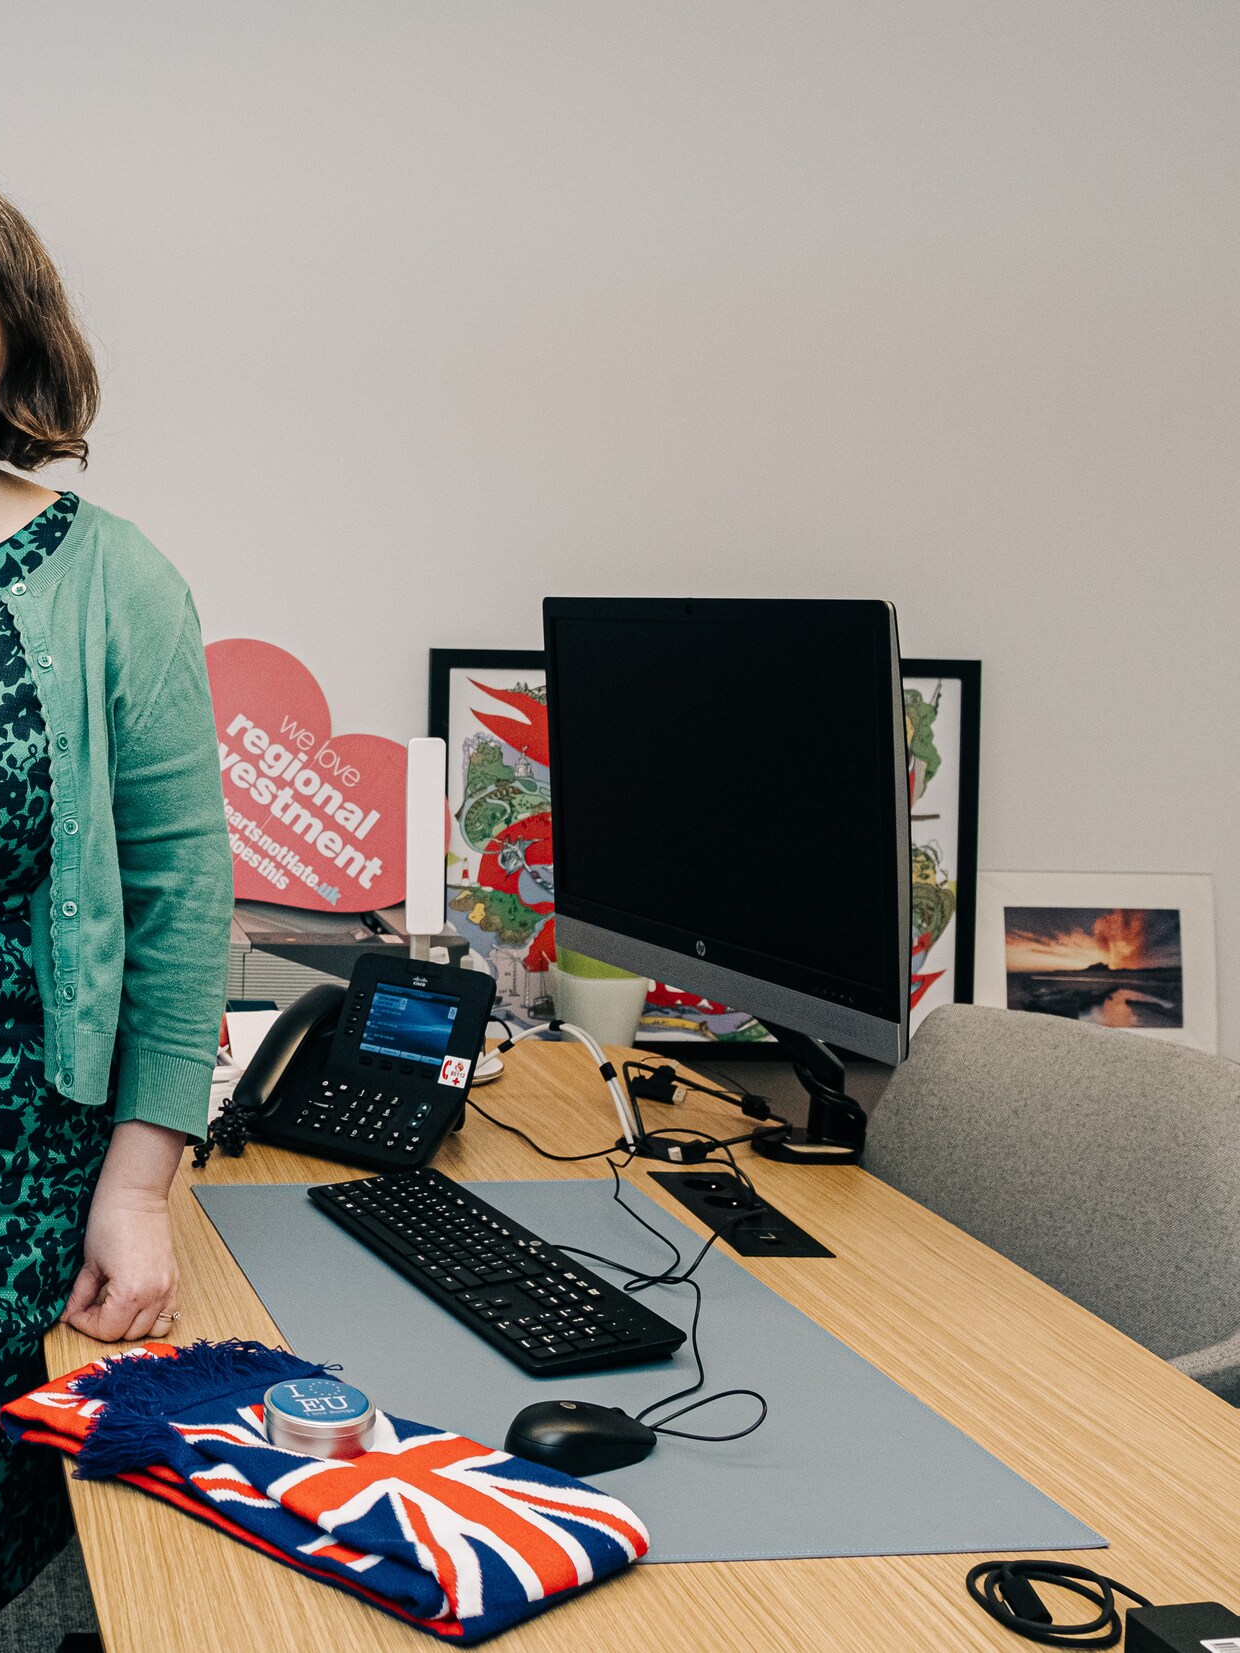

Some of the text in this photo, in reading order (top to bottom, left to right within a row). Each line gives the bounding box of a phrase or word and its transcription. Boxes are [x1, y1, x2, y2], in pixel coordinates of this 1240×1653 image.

[226, 713, 381, 840] regional
[279, 715, 361, 787] we love
[217, 738, 383, 890] vestment
[284, 1384, 305, 1398] I
[295, 1396, 349, 1413] EU
